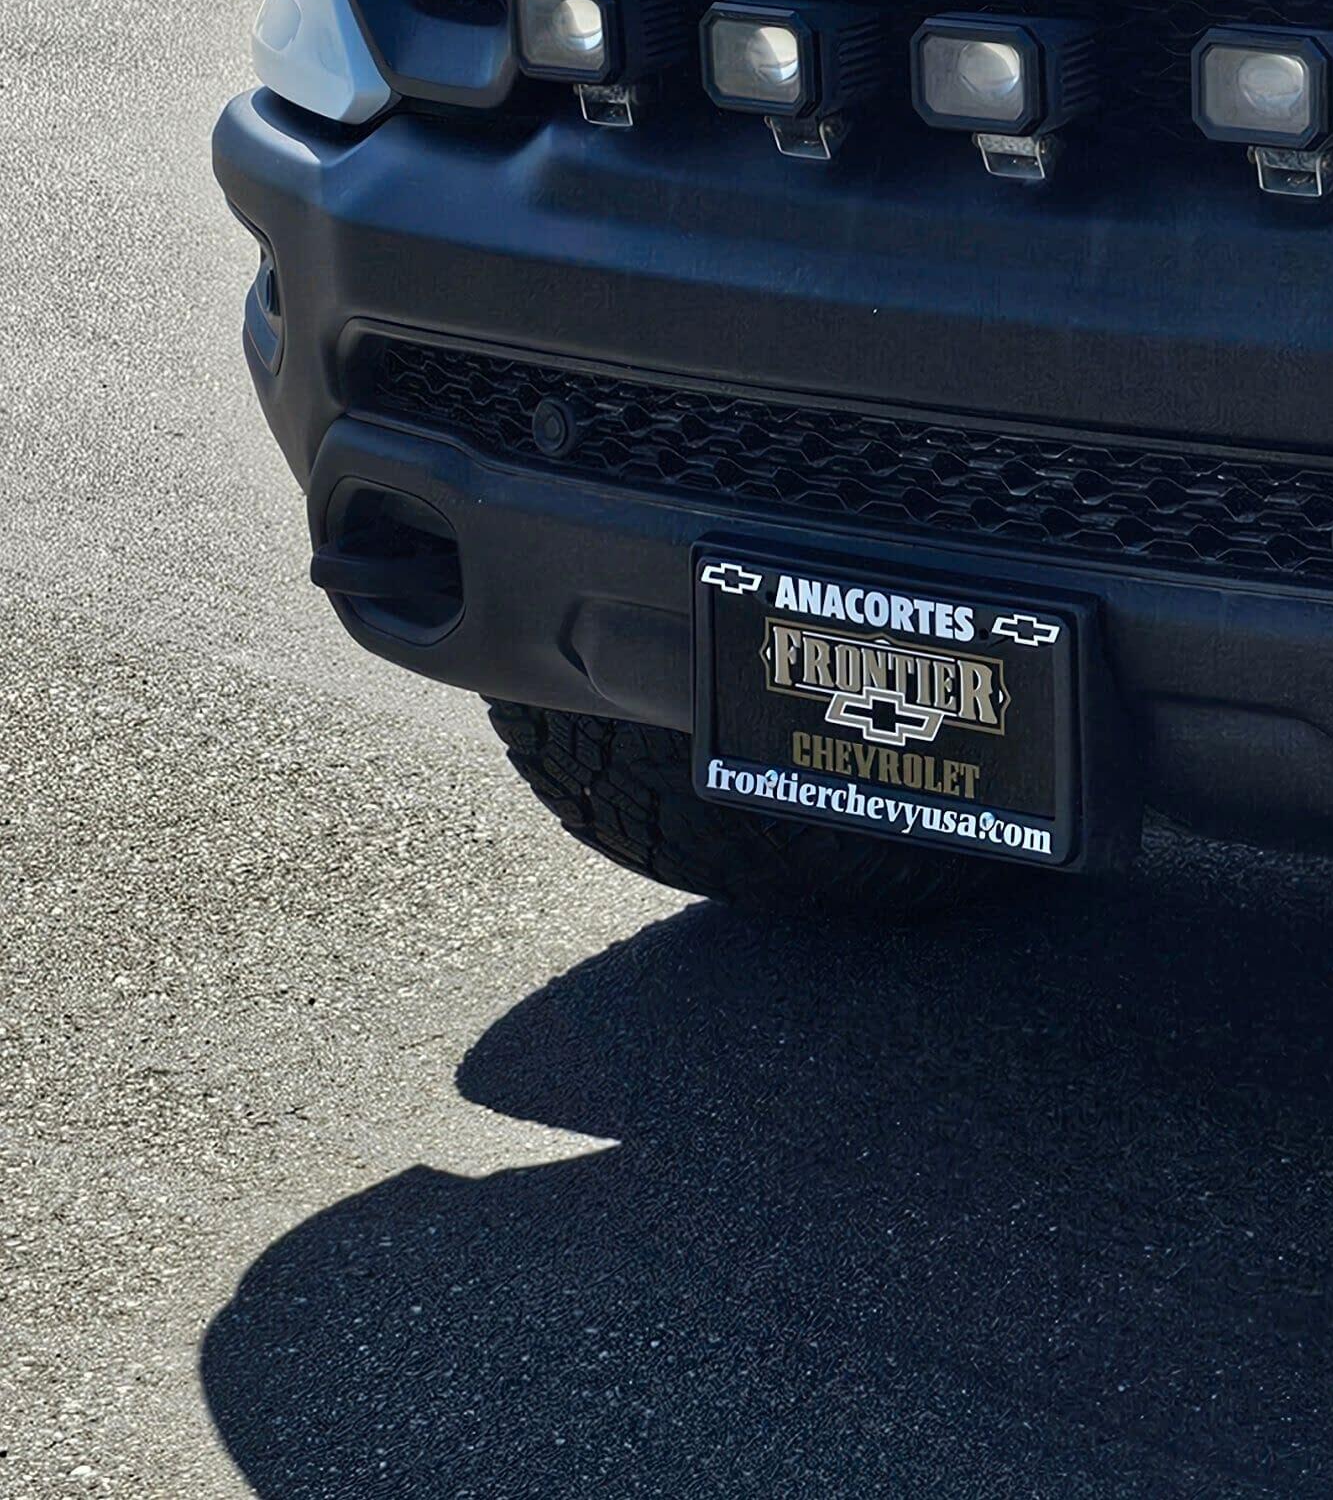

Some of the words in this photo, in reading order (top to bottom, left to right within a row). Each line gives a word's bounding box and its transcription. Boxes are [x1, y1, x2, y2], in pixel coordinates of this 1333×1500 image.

[774, 575, 975, 642] ANACORTES
[772, 625, 998, 726] FRONTIER
[706, 758, 1052, 855] frontierchevyusa.com
[791, 730, 980, 800] CHEVROLET
